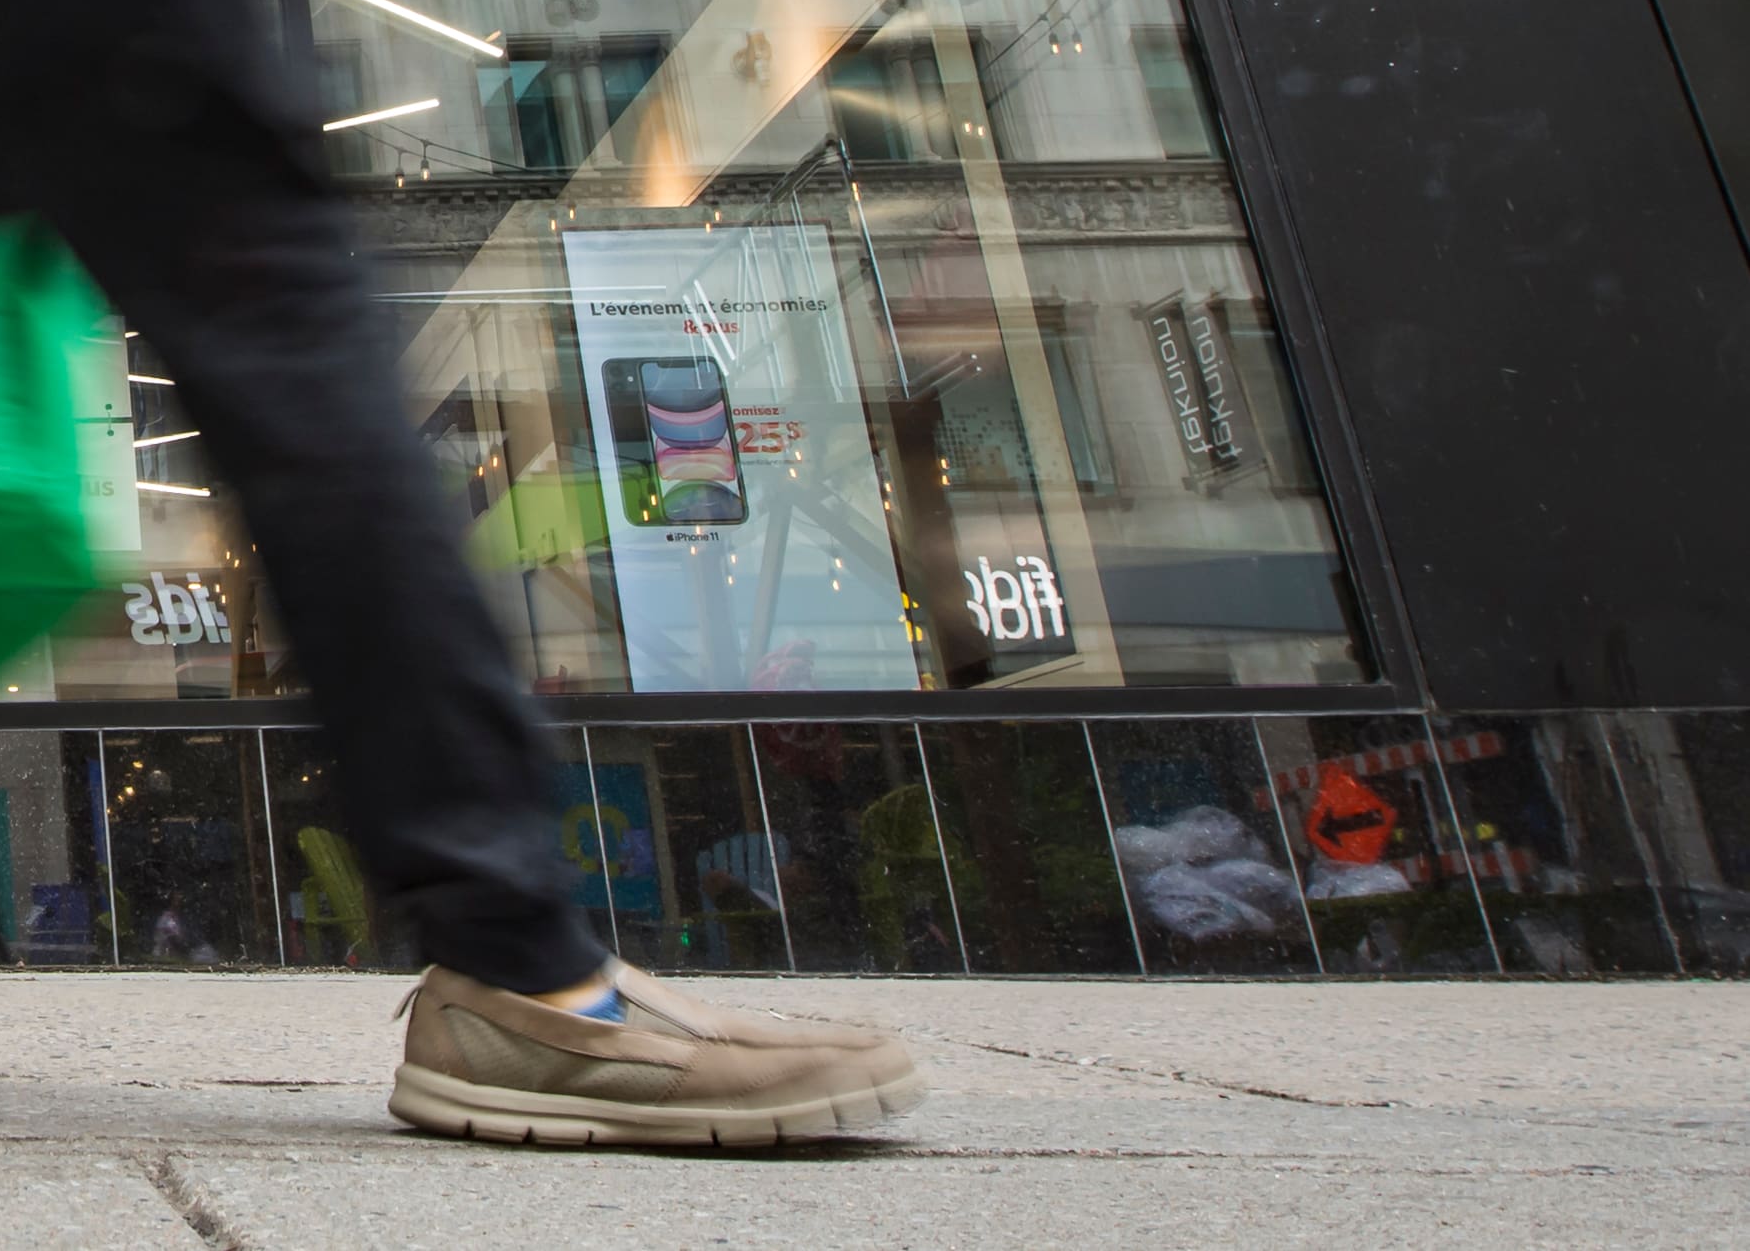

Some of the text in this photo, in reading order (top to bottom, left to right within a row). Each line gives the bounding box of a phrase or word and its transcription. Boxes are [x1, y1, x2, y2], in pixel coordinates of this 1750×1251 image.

[721, 297, 827, 314] économies
[674, 531, 719, 542] iPhone 11
